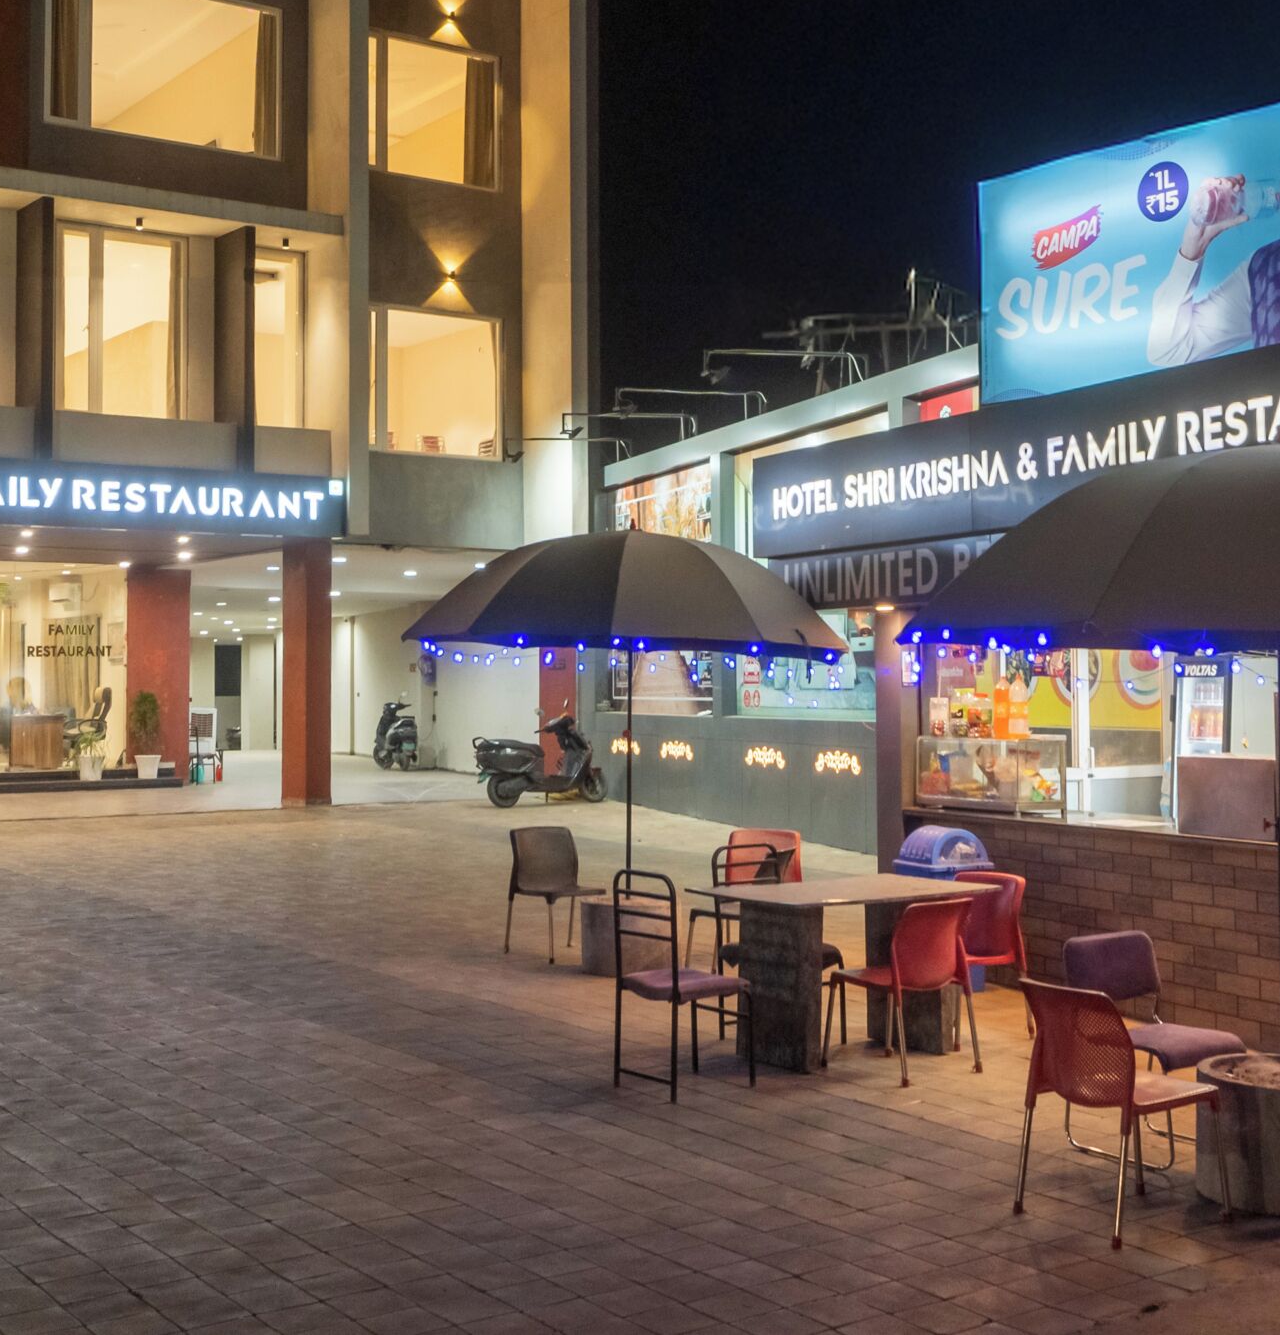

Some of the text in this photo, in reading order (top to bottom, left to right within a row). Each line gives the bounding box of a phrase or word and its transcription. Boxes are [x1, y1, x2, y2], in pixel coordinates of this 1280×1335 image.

[1146, 189, 1180, 215] ₹15
[1036, 215, 1098, 259] CAMPA
[995, 254, 1147, 342] SURE
[772, 478, 838, 521] HOTEL
[844, 467, 895, 509] SHRI
[900, 450, 1009, 502] KRISHNA
[1016, 442, 1039, 482] &
[1046, 415, 1166, 477] FAMILY
[72, 479, 324, 521] RESTAURANT
[783, 547, 939, 602] UNLIMITED
[27, 645, 112, 657] RESTAURANT
[48, 624, 96, 636] FAMILY
[1184, 664, 1218, 676] VOLTAS
